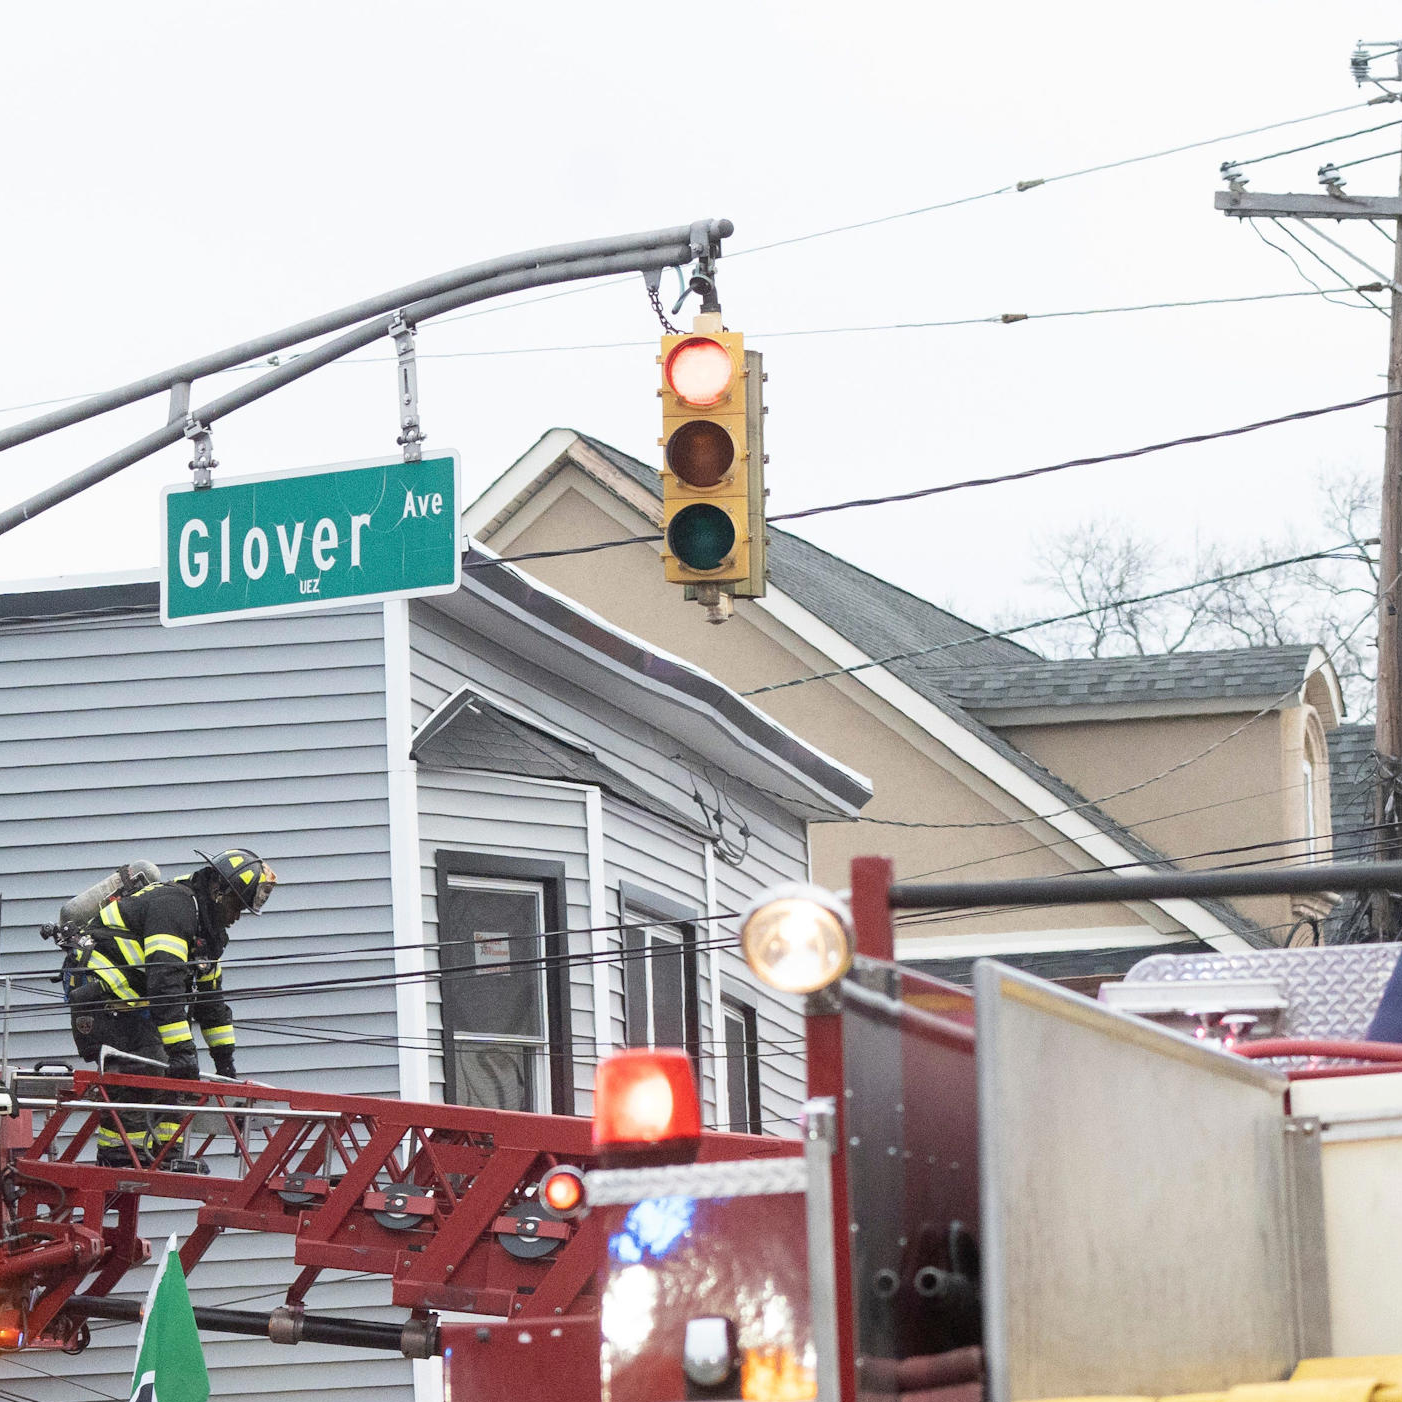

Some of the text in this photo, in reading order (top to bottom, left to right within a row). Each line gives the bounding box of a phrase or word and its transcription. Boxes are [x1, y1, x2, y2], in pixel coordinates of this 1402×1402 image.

[178, 490, 443, 589] Glover Ave
[299, 577, 320, 594] UEZ
